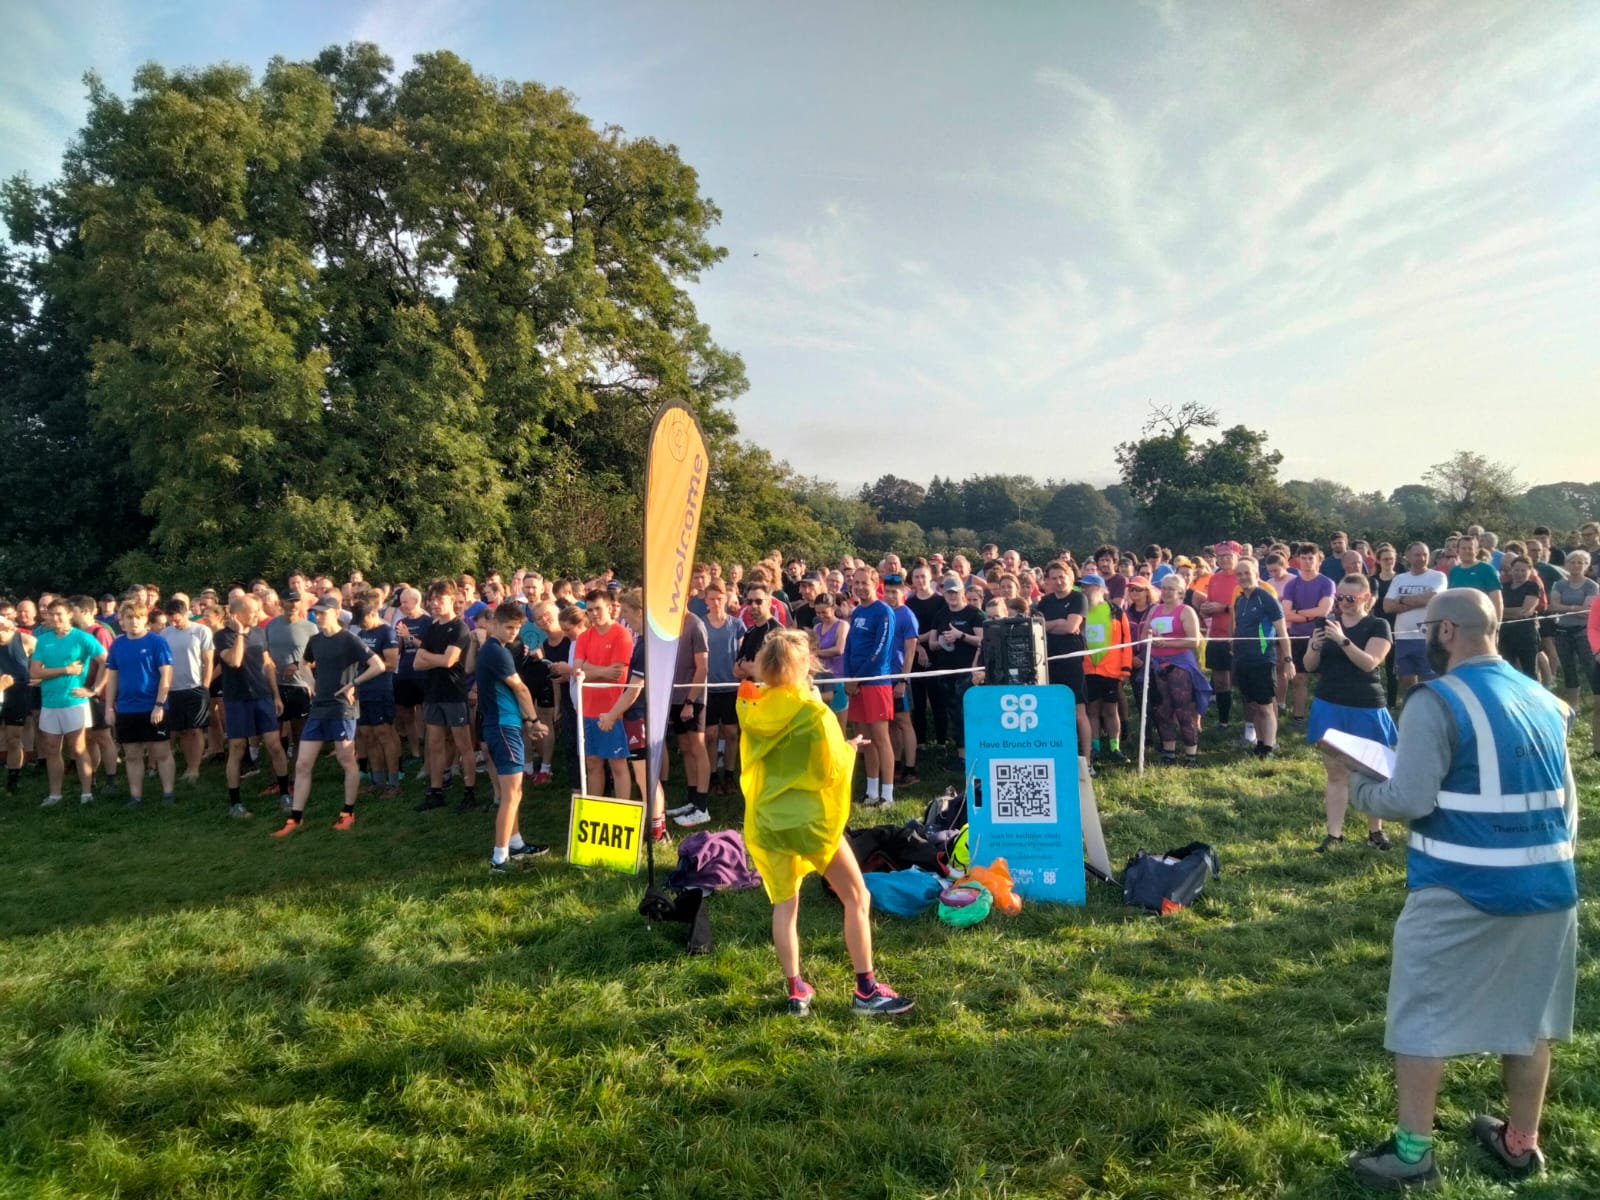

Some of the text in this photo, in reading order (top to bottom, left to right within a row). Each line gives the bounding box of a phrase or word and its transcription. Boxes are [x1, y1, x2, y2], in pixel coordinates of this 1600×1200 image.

[669, 453, 704, 614] welcome
[979, 739, 1063, 749] Have Brunch On Us!
[577, 819, 635, 850] START
